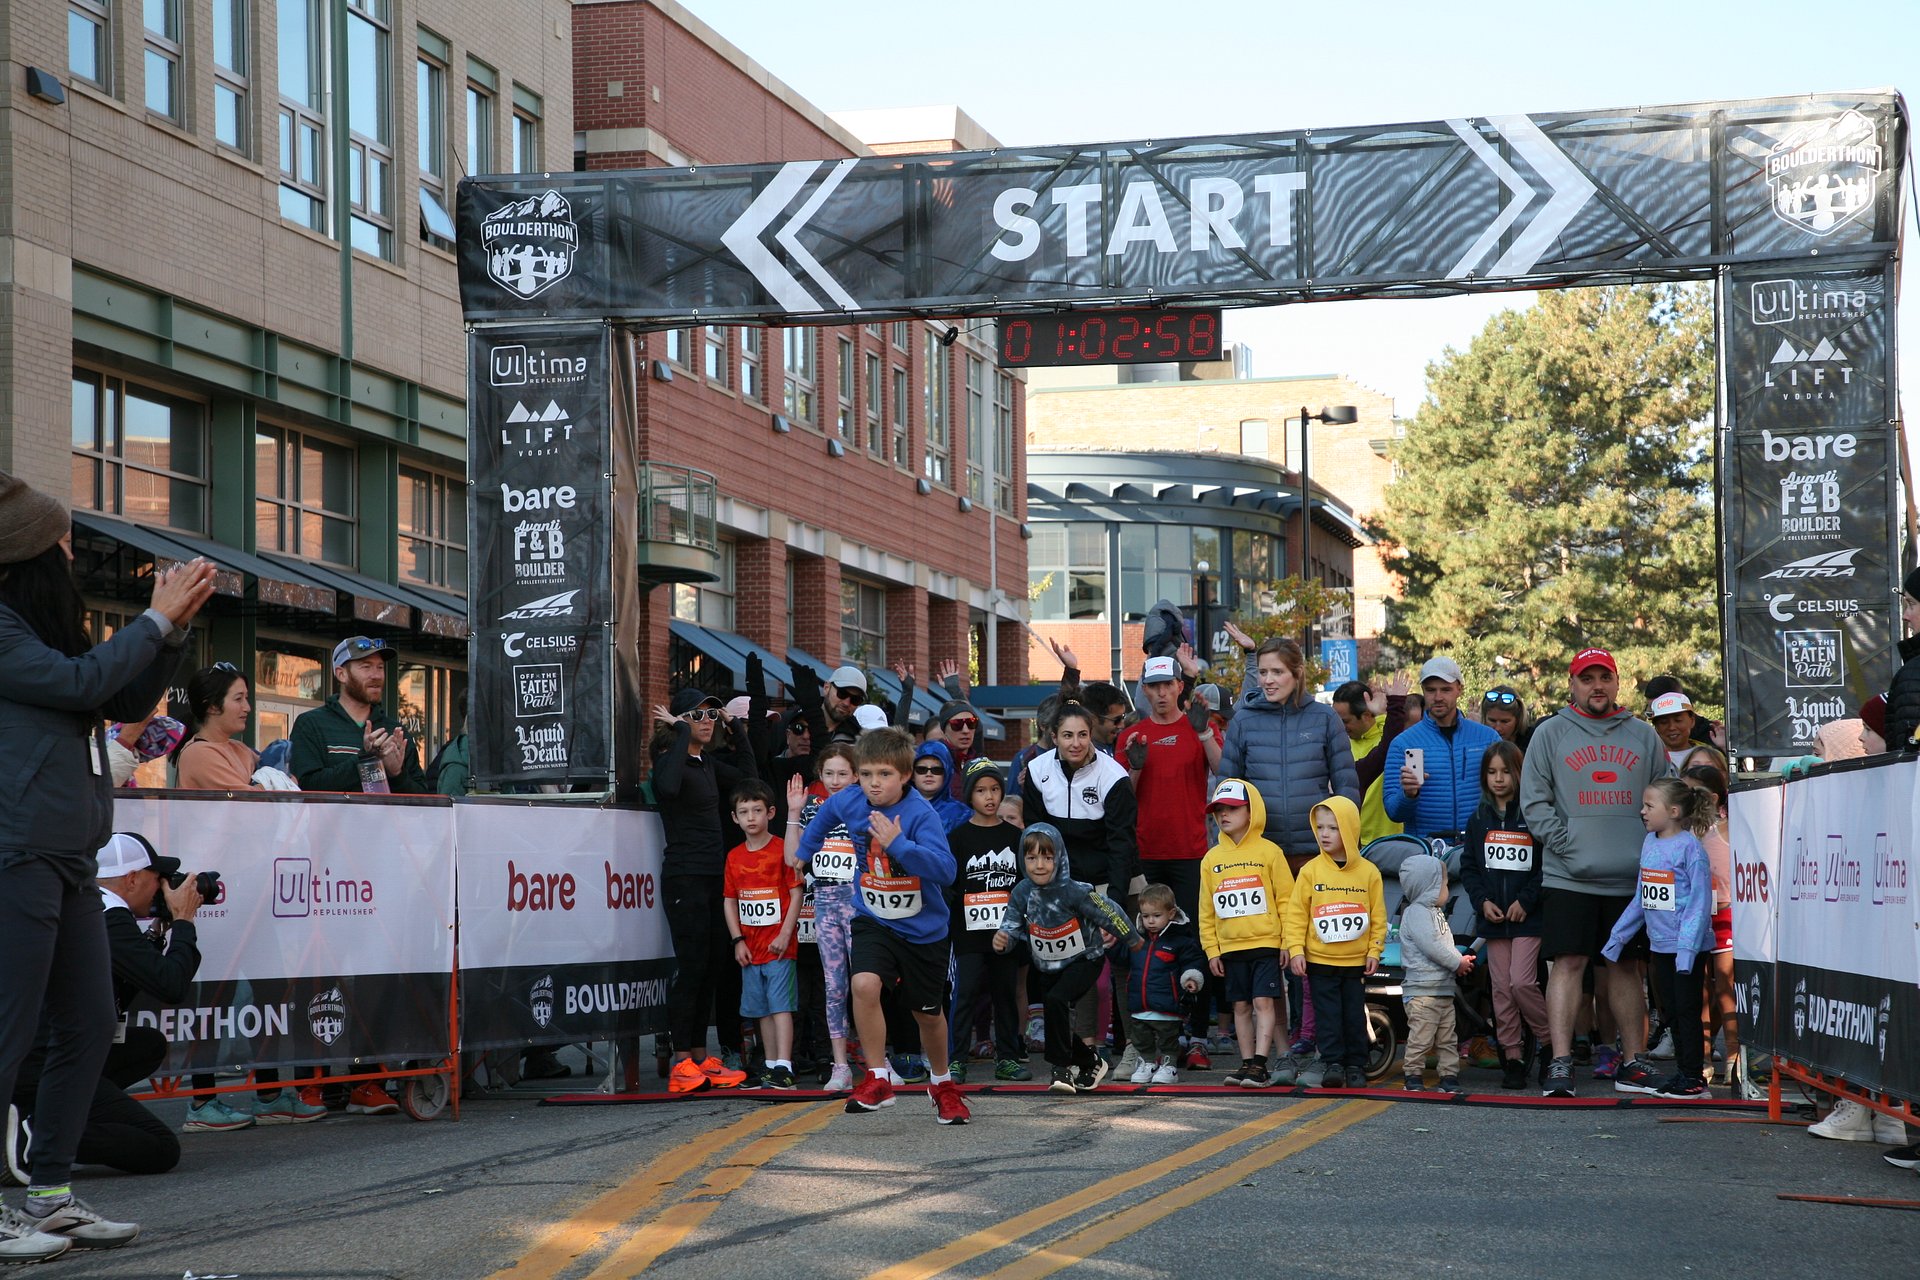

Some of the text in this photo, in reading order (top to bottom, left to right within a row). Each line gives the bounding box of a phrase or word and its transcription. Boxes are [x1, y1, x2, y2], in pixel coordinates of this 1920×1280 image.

[1771, 146, 1876, 176] BOULDERTHON
[990, 172, 1307, 262] START
[485, 222, 574, 242] BOULDERTHON
[1759, 284, 1867, 315] Ultima
[1799, 311, 1865, 319] REPLENISHER
[496, 349, 587, 376] Ultima
[529, 375, 584, 384] REPLENISHER
[1765, 368, 1853, 387] LIFT
[1783, 392, 1835, 400] VODKA
[502, 425, 573, 445] LIFT
[518, 448, 559, 457] VODKA
[1762, 430, 1857, 462] bare
[1780, 470, 1838, 486] Avanti
[501, 483, 576, 513] bare
[514, 519, 561, 533] Avanti
[1782, 516, 1841, 532] BOULDER
[515, 562, 565, 577] BOULDER
[1759, 567, 1856, 579] ALTRA
[498, 606, 573, 620] ALTRA
[1798, 600, 1859, 612] CELSIUS
[526, 636, 576, 648] CELSIUS
[1212, 630, 1230, 653] 42
[1791, 647, 1836, 663] EATEN
[1331, 662, 1350, 677] ND
[1795, 661, 1834, 678] Path
[520, 679, 557, 694] EATEN
[523, 692, 556, 708] Path
[1785, 696, 1845, 723] Liquid
[515, 723, 565, 748] Liquid
[521, 743, 567, 764] Death
[1565, 744, 1640, 772] OHIO STATE
[1579, 790, 1633, 805] BUCKEYES
[815, 854, 853, 870] 9004
[1488, 846, 1528, 862] 9030
[1213, 861, 1265, 873] Champion
[280, 867, 373, 903] Ultima
[1734, 850, 1768, 903] bare
[507, 860, 654, 911] bare bare
[1314, 883, 1367, 895] Champion
[866, 891, 915, 908] 9197
[1218, 891, 1261, 909] 9016
[741, 902, 775, 916] 9005
[1319, 916, 1363, 934] 9199
[1034, 935, 1076, 953] 9191
[566, 978, 667, 1014] BOULDERTHON
